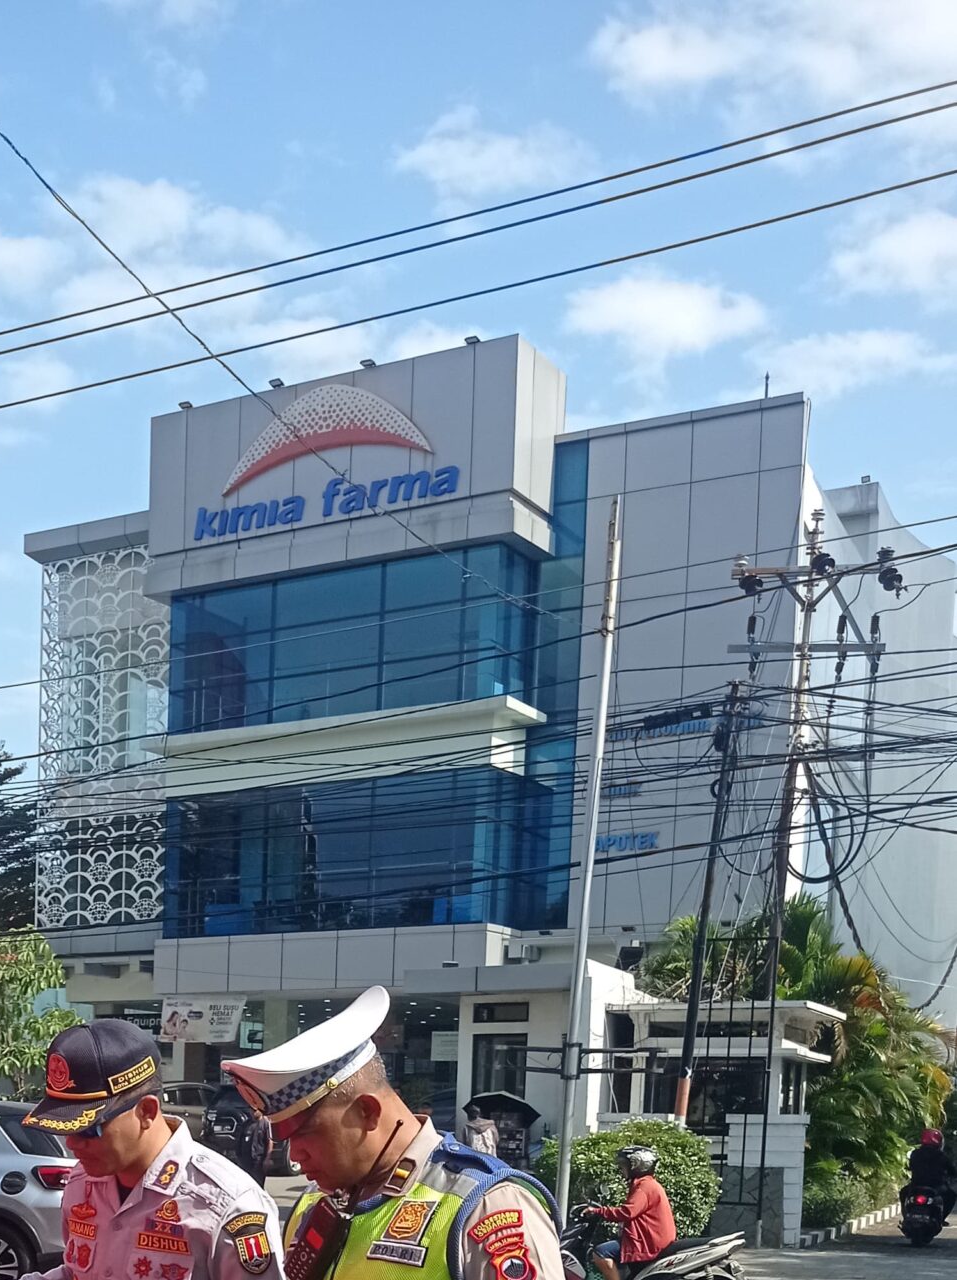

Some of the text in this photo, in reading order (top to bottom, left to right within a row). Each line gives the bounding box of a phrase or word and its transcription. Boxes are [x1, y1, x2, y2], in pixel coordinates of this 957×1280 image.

[193, 464, 460, 541] kimia farma
[117, 1063, 149, 1083] DISHUB
[139, 1235, 187, 1253] DISHUB
[373, 1244, 415, 1261] POLRI
